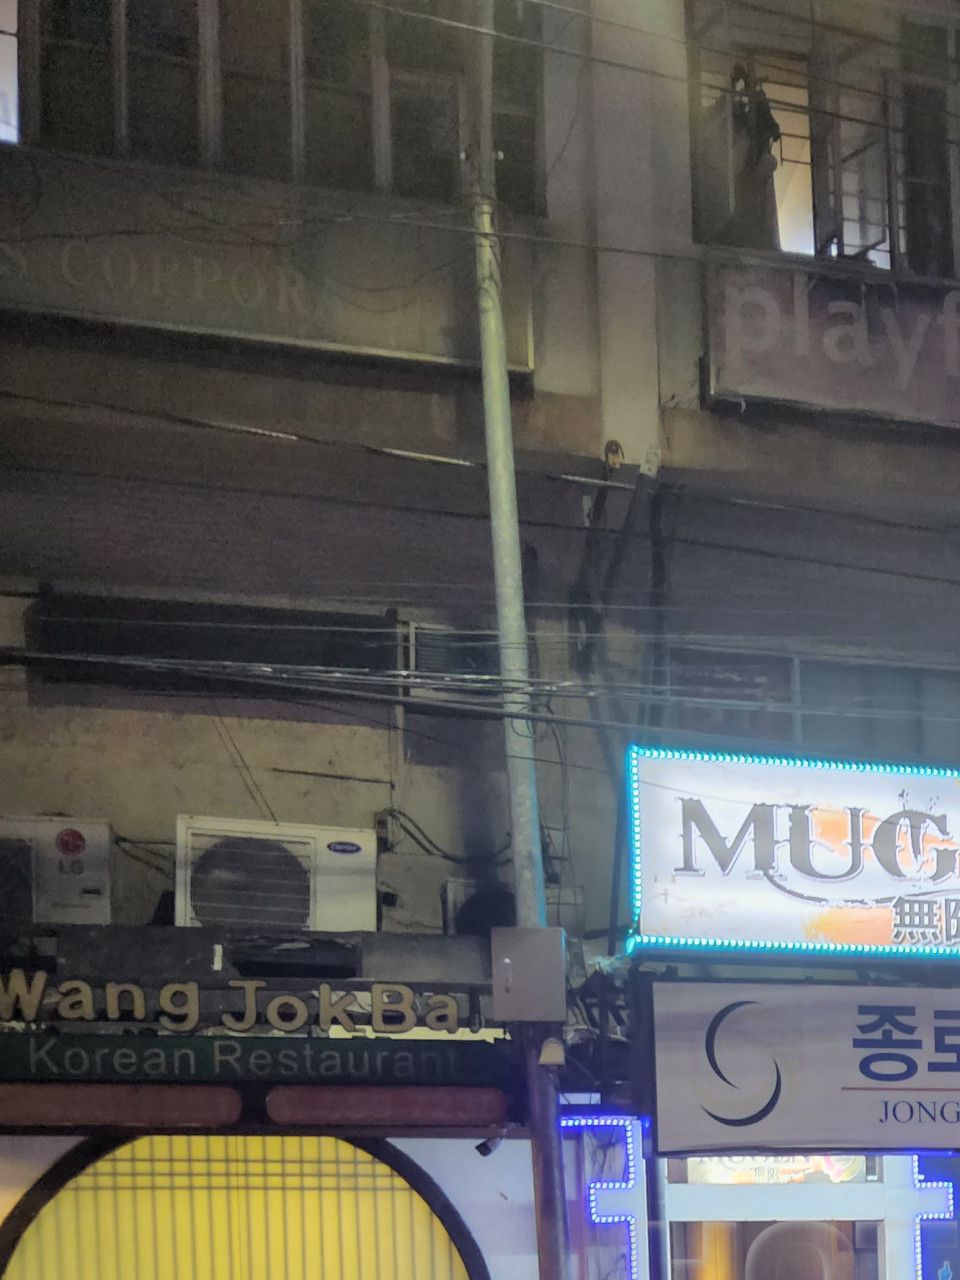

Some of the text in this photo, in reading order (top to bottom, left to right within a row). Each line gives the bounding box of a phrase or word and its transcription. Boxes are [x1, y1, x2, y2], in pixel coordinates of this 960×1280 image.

[0, 967, 201, 1034] Wang
[29, 1038, 457, 1077] Korean Restaurant
[878, 1099, 960, 1126] JONG
